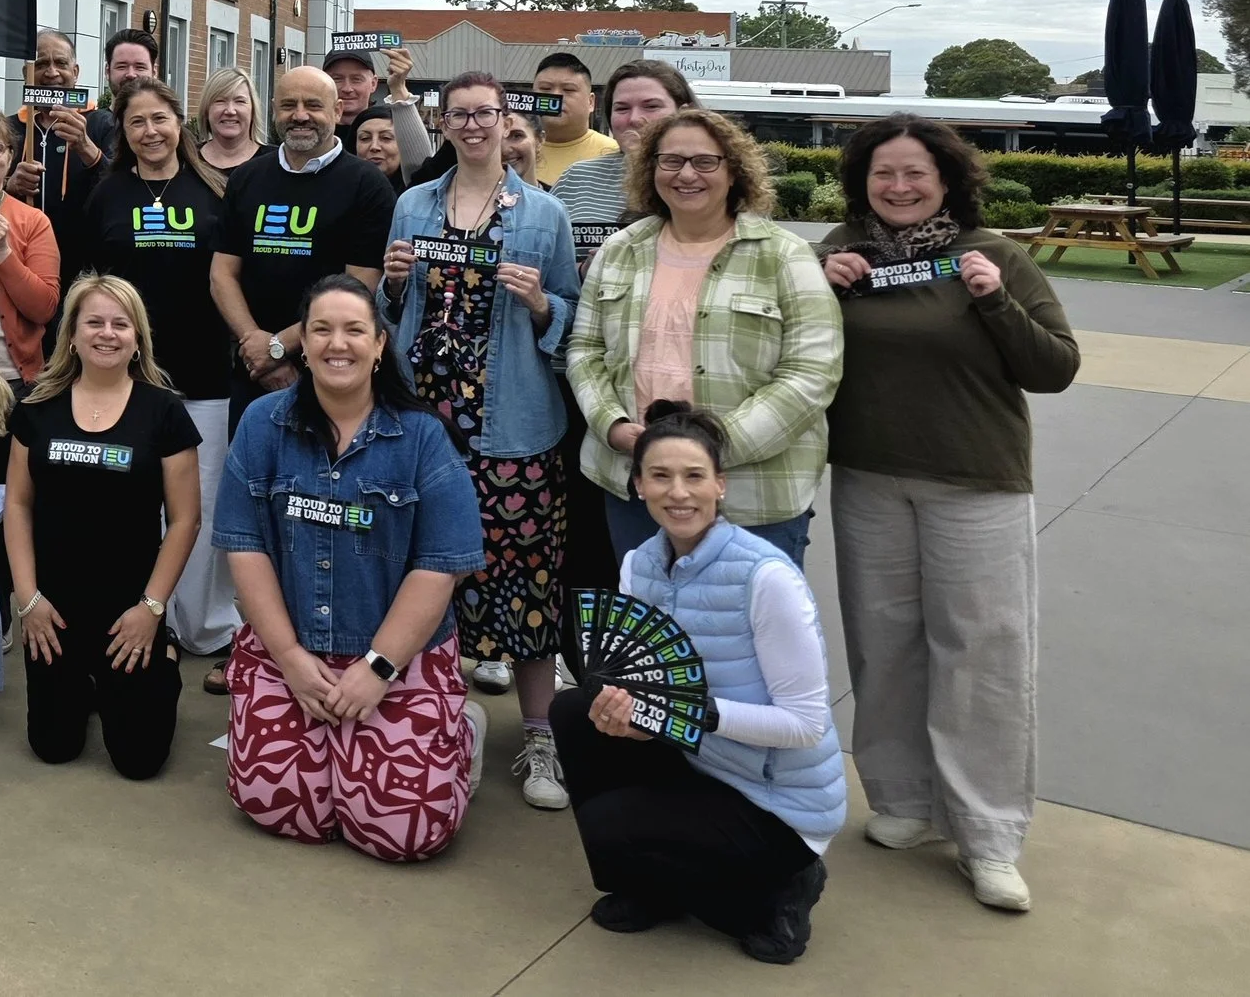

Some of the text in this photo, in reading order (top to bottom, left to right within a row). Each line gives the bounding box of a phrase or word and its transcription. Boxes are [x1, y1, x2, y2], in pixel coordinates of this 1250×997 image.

[333, 34, 377, 44] PROUD TO
[347, 42, 377, 50] UNION
[380, 36, 399, 45] IEU
[66, 93, 86, 103] IEU
[521, 95, 534, 103] TO
[536, 98, 560, 110] IEU
[508, 102, 533, 111] NION
[133, 206, 194, 230] IEU
[254, 205, 318, 235] IEU
[414, 240, 467, 254] PROUD TO
[414, 249, 466, 263] BE UNION
[470, 249, 497, 263] IEU
[870, 261, 931, 278] PROUD TO
[871, 270, 932, 288] BE UNION
[50, 442, 101, 454] PROUD TO
[49, 451, 99, 464] BE UNION
[103, 449, 129, 464] IEU
[288, 496, 342, 514] PROUD TO
[287, 506, 341, 525] BE UNION
[345, 508, 373, 525] IEU
[644, 669, 664, 682] TO
[667, 666, 702, 685] IEU
[648, 705, 666, 721] TO
[666, 717, 700, 743] IEU
